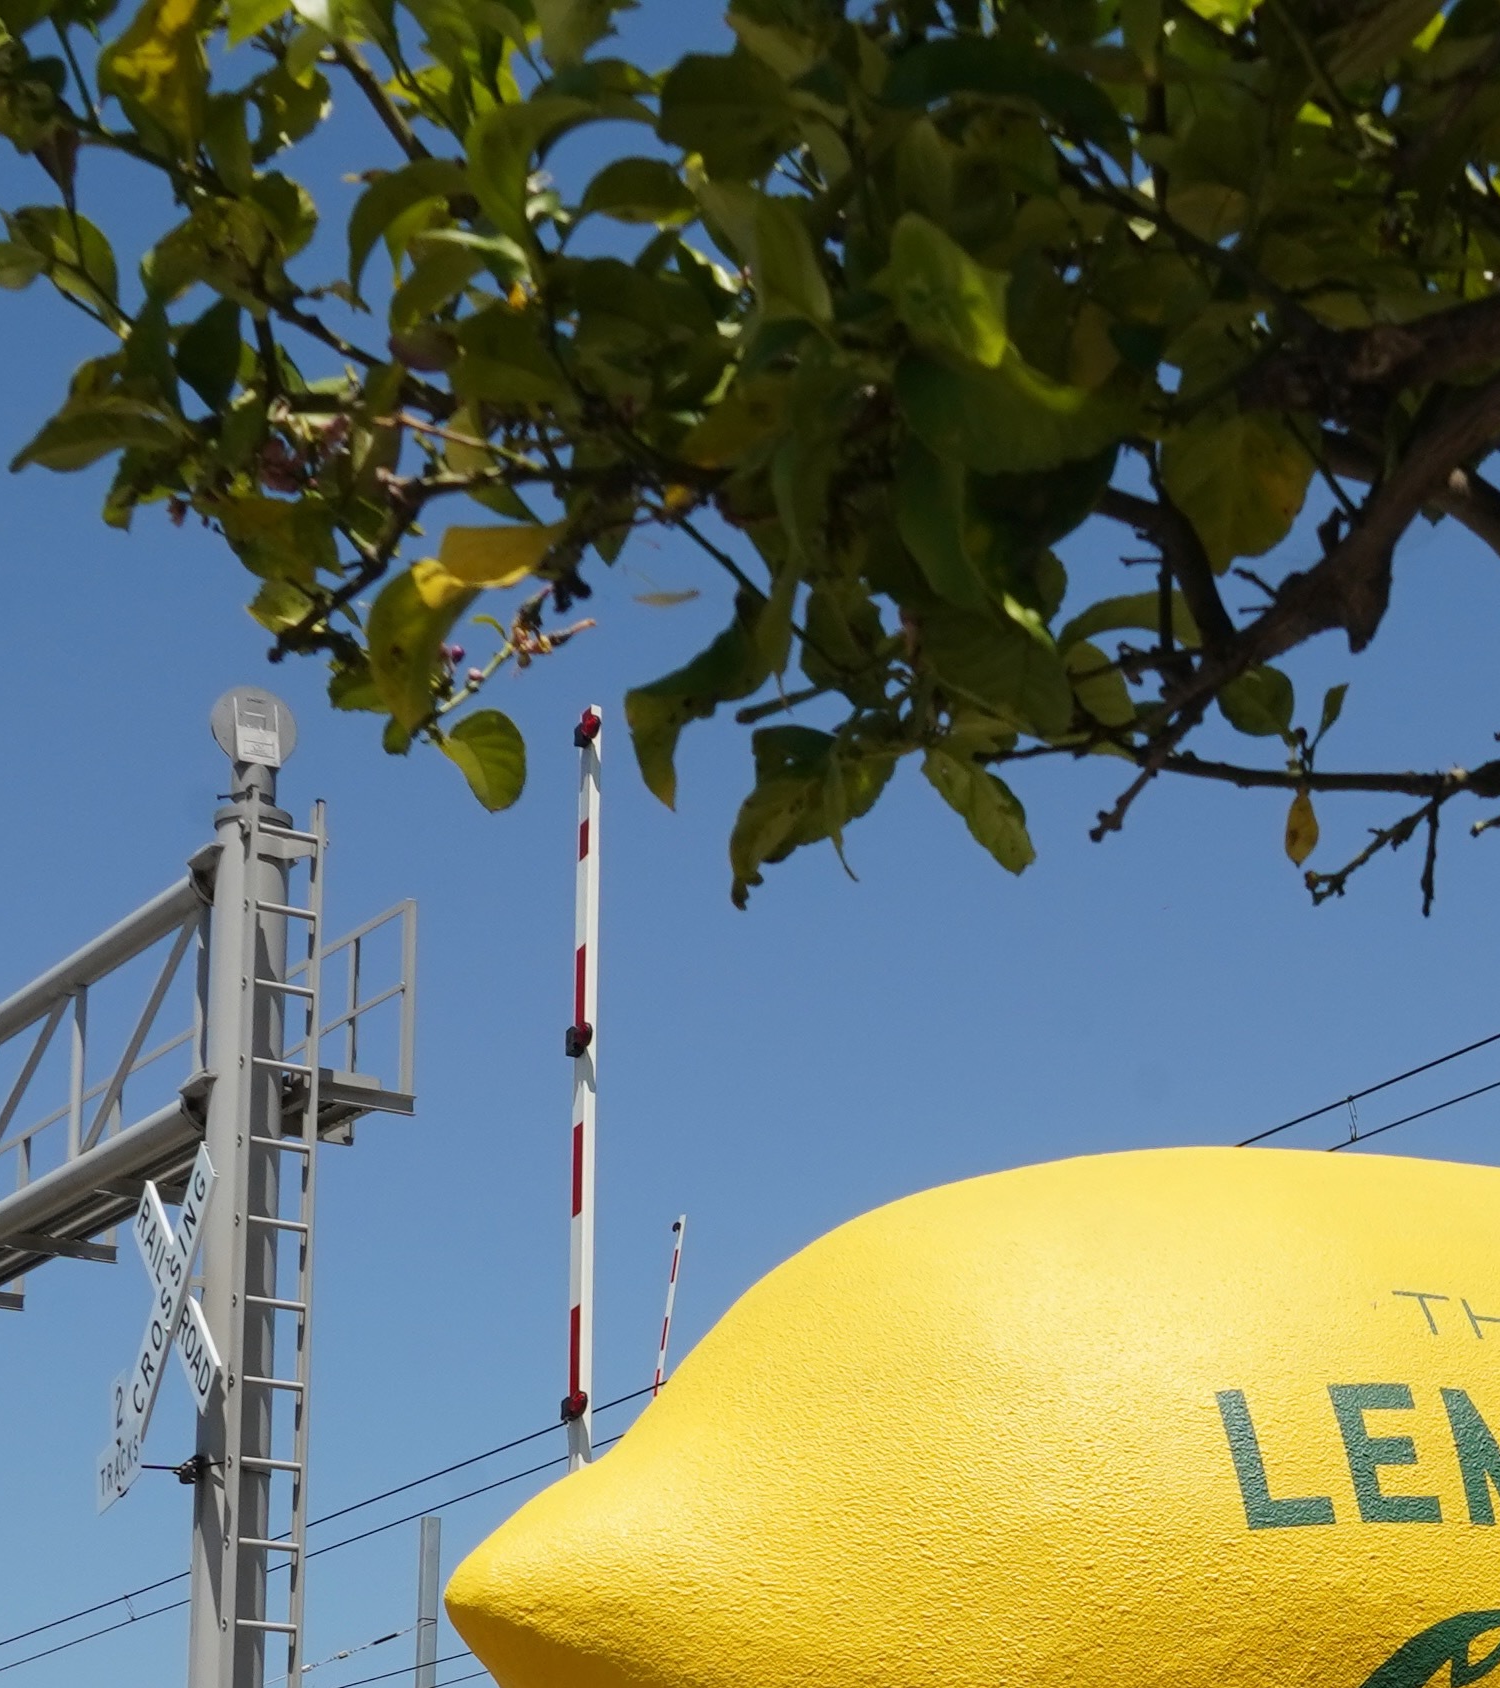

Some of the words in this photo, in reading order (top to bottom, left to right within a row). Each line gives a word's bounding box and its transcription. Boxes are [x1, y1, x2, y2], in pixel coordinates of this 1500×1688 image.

[132, 1168, 207, 1414] CROSSING
[137, 1197, 167, 1284] RAIL
[176, 1301, 212, 1397] ROAD
[100, 1434, 140, 1498] TRACKS
[114, 1386, 124, 1429] 2
